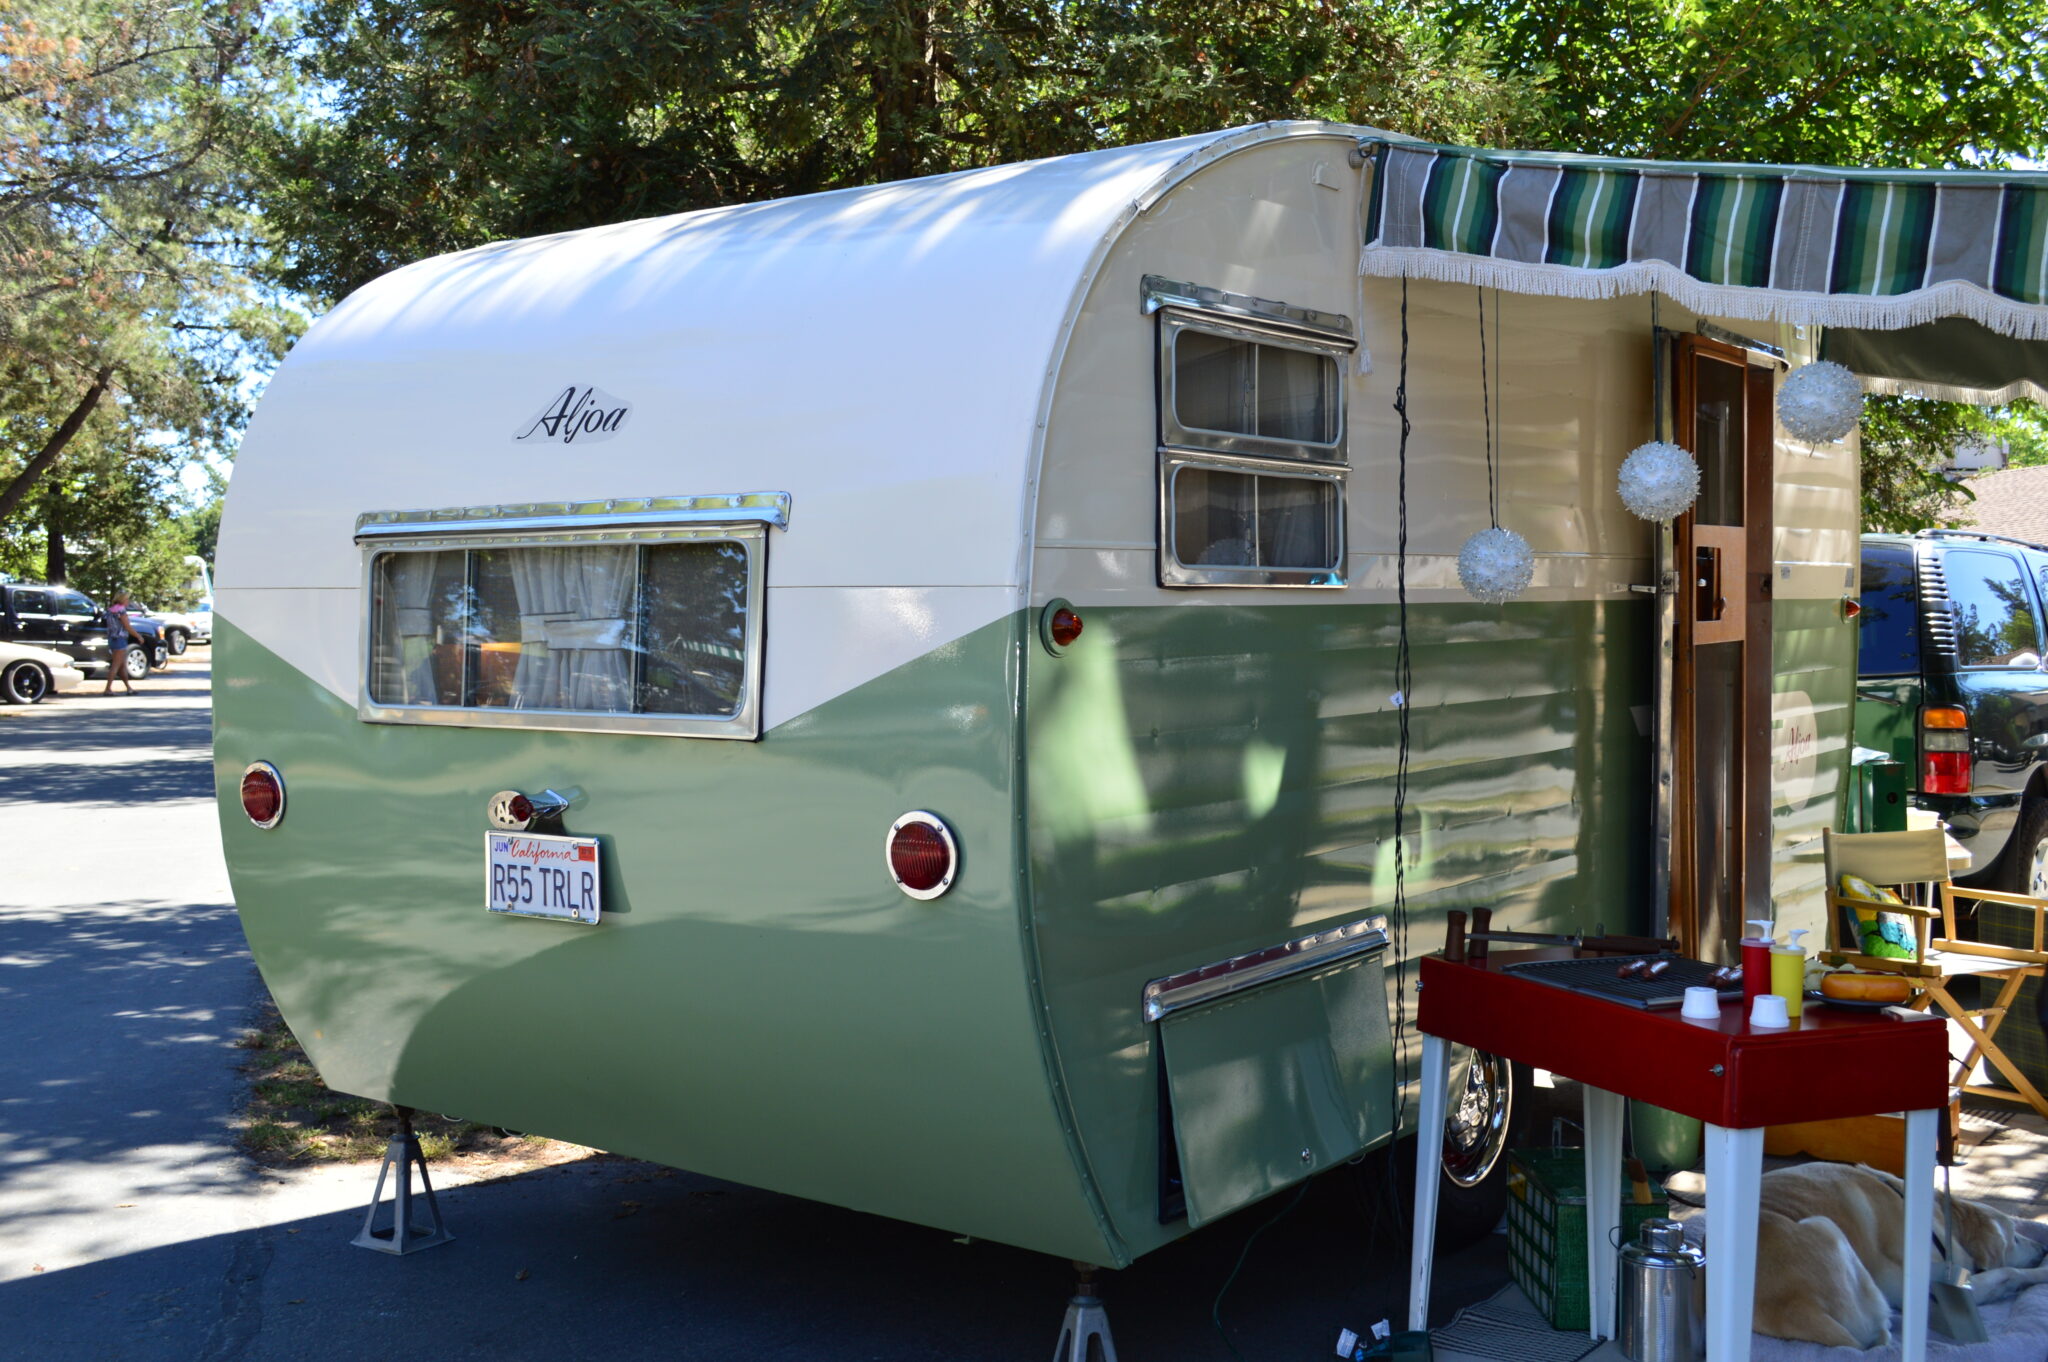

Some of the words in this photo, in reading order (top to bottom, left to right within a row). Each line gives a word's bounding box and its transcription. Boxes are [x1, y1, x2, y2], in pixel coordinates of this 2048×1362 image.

[516, 386, 628, 444] Aljoa
[495, 841, 509, 852] JUN
[511, 839, 579, 865] California
[494, 863, 533, 904] R55
[539, 867, 594, 911] TRLR
